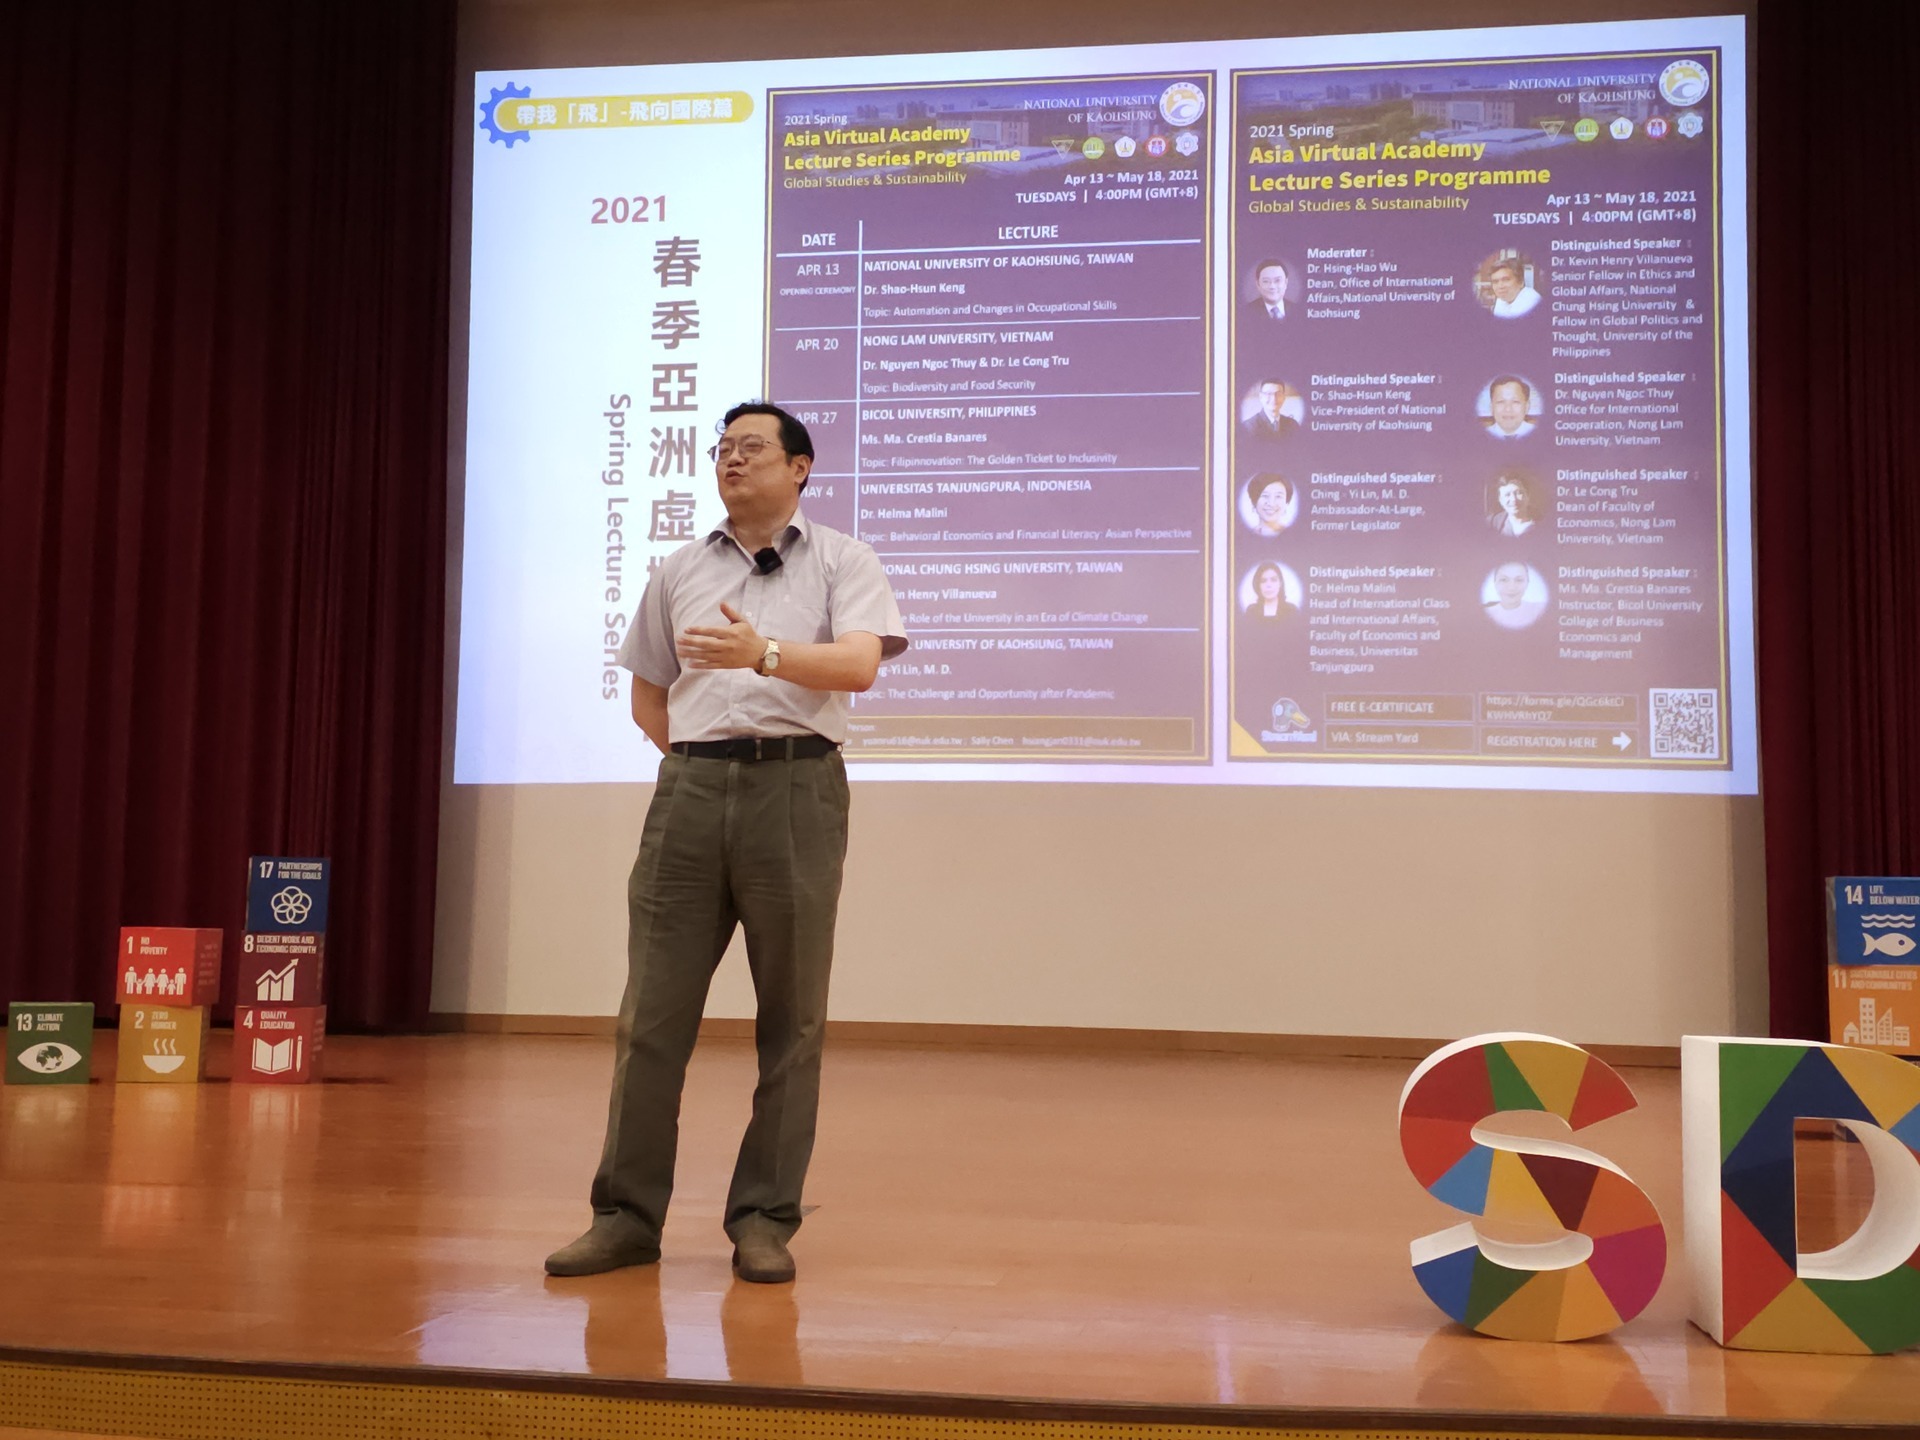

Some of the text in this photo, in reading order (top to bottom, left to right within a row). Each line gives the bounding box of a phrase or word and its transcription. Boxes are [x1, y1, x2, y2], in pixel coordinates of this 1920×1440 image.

[1508, 73, 1656, 90] NATIONAL UNIVERSITY
[1023, 95, 1157, 109] NATIONAL UNIVERSITY
[784, 113, 848, 127] 2021 Spring
[783, 126, 971, 146] Asia Virtual Academy
[1250, 124, 1334, 139] 2021 Spring
[784, 150, 1020, 170] Lecture Series Programme
[1248, 141, 1486, 163] Asia Virtual Academy
[783, 169, 967, 188] Global Studies & Sustainability
[1064, 169, 1198, 186] Apr 13 May 18, 2021
[1250, 169, 1550, 191] Lecture Series Programme
[1015, 186, 1198, 203] TUESDAYS 4:00PM (GMT+8)
[1546, 190, 1696, 207] Apr 13 May 18, 2021
[591, 195, 666, 224] 2021
[1248, 196, 1469, 213] Global Studies & Sustainability
[1492, 208, 1696, 224] TUESDAYS 4:00PM (GMT+8)
[802, 233, 836, 246] DATE
[998, 225, 1058, 239] LECTURE
[796, 263, 839, 276] APR 13
[864, 252, 1133, 271] NATIONAL UNIVERSITY OF KAOHSIUNG, TAIWAN
[795, 338, 839, 350] APR 20
[863, 331, 1053, 346] NONG LAM UNIVERSITY, VIETNAM
[879, 360, 920, 372] Nguyen
[922, 359, 948, 371] Ngoc
[950, 358, 977, 369] Thuy
[978, 356, 988, 367] &
[1008, 357, 1020, 367] Le
[1022, 356, 1049, 368] Cong
[1051, 355, 1069, 365] Tru
[646, 236, 701, 584] 春季亞洲虛
[822, 411, 837, 424] 27
[862, 405, 1036, 420] BICOL UNIVERSITY, PHILIPPINES
[602, 394, 631, 486] Spring
[826, 486, 833, 497] 4
[860, 480, 1092, 494] UNIVERSITAS TANJUNGPURA, INDONESIA
[605, 498, 629, 603] Lecture
[259, 861, 274, 879] 17
[1845, 885, 1863, 905] 14
[1869, 885, 1883, 894] LIFE
[1870, 896, 1895, 905] BELOW
[126, 936, 133, 954] 1
[140, 946, 168, 955] POVERTY
[244, 934, 254, 953] 8
[1833, 969, 1847, 989] 11
[16, 1013, 32, 1031] 13
[37, 1013, 64, 1022] CLIMATE
[134, 1010, 144, 1029] 2
[243, 1010, 253, 1029] 4
[260, 1011, 287, 1020] QUALITY
[36, 1023, 60, 1031] ACTION
[260, 1021, 295, 1029] EDUCATION
